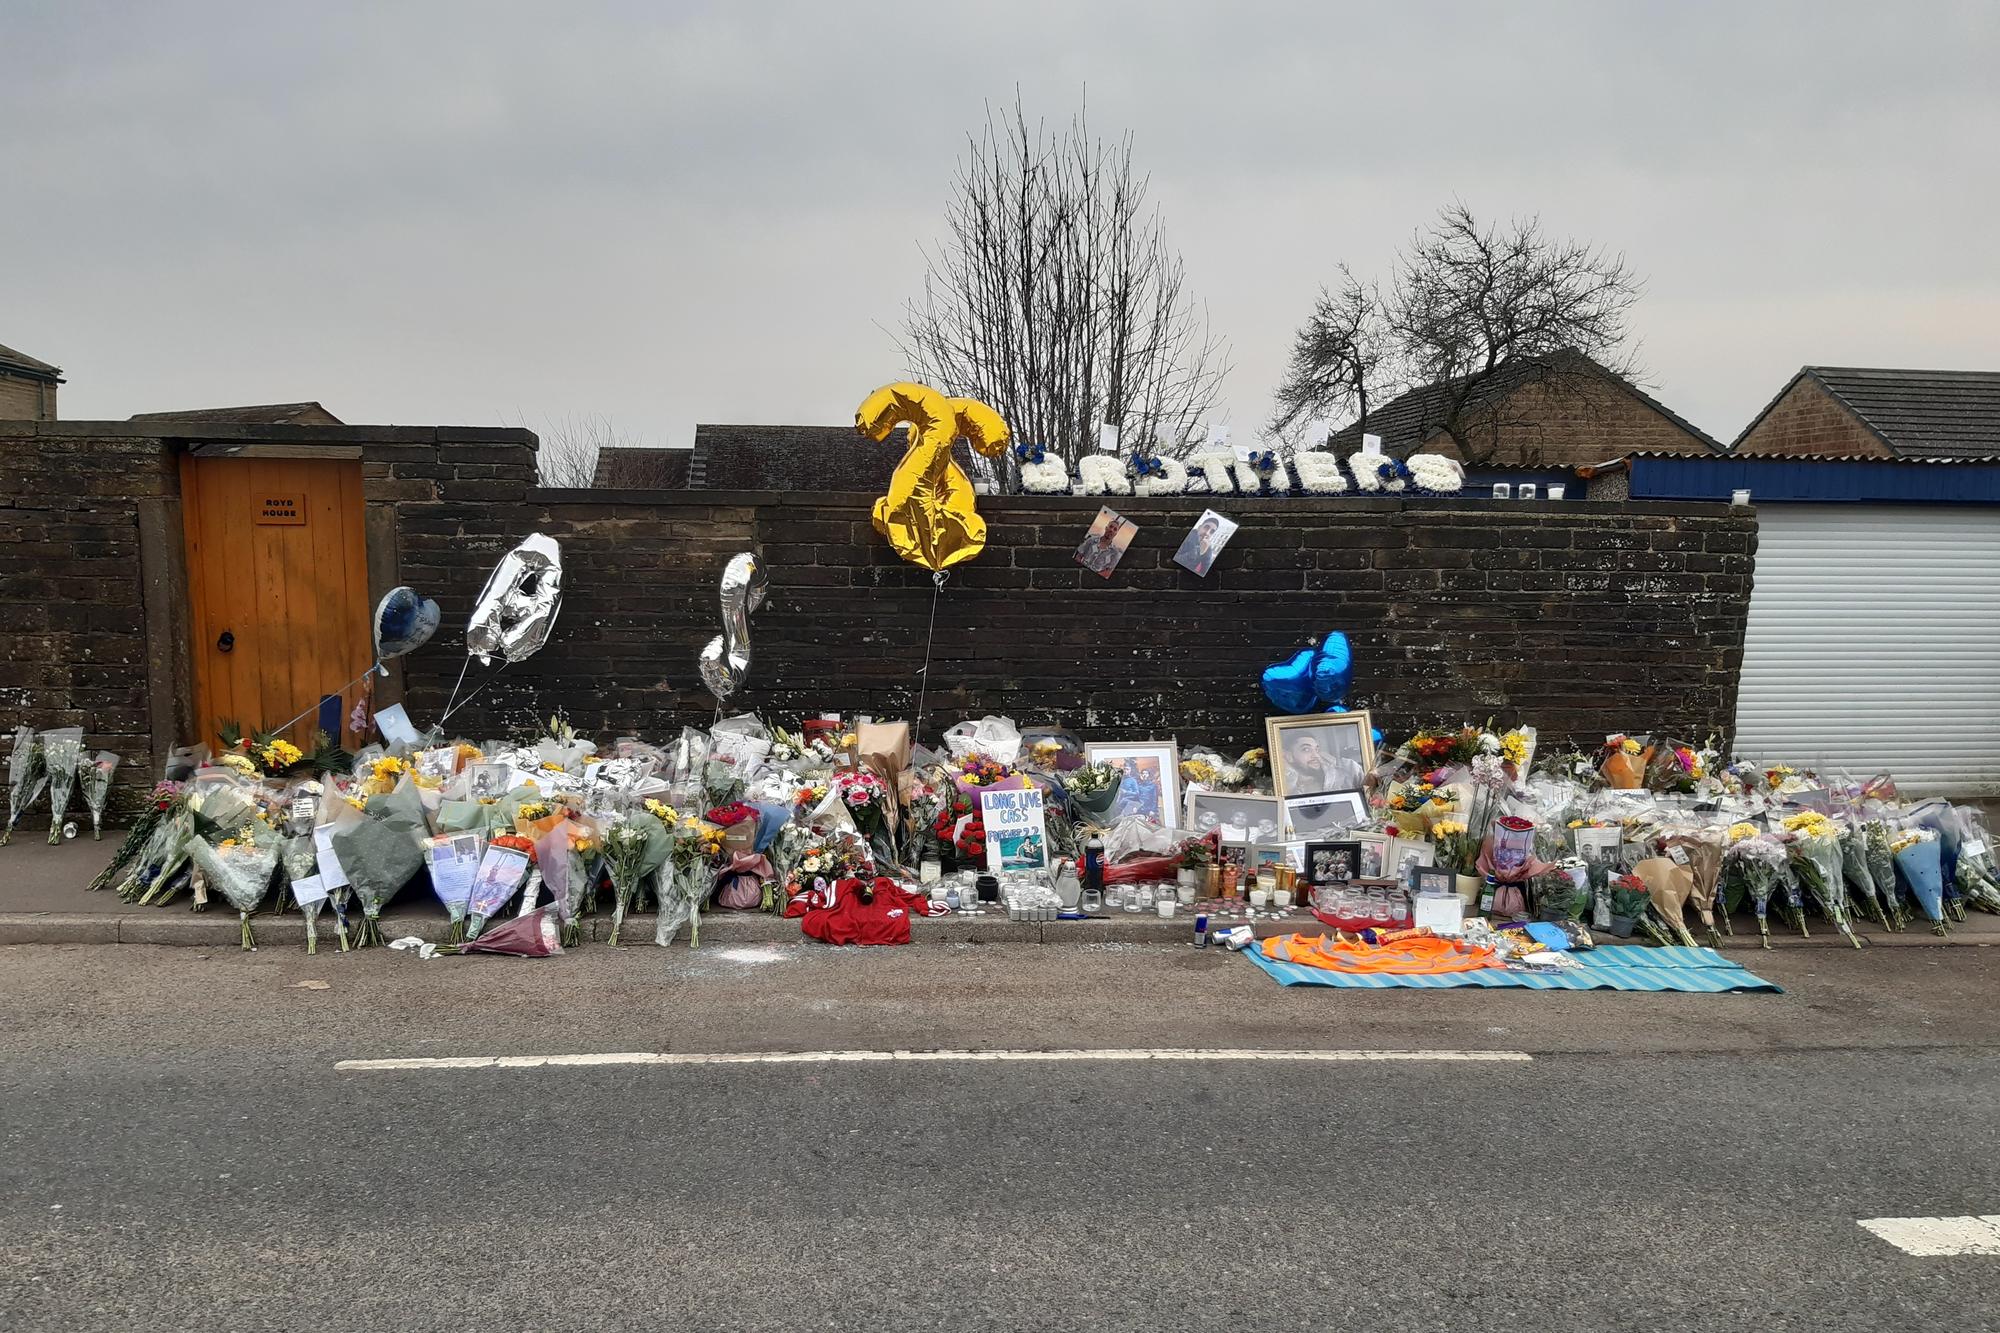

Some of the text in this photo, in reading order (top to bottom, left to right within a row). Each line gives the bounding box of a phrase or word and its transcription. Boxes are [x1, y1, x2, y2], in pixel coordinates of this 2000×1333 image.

[1020, 451, 1462, 494] BROTHERS
[265, 499, 293, 507] ROYD
[262, 509, 296, 517] HOUSE
[983, 791, 1042, 810] LONG LIVE
[1000, 808, 1029, 824] CASS
